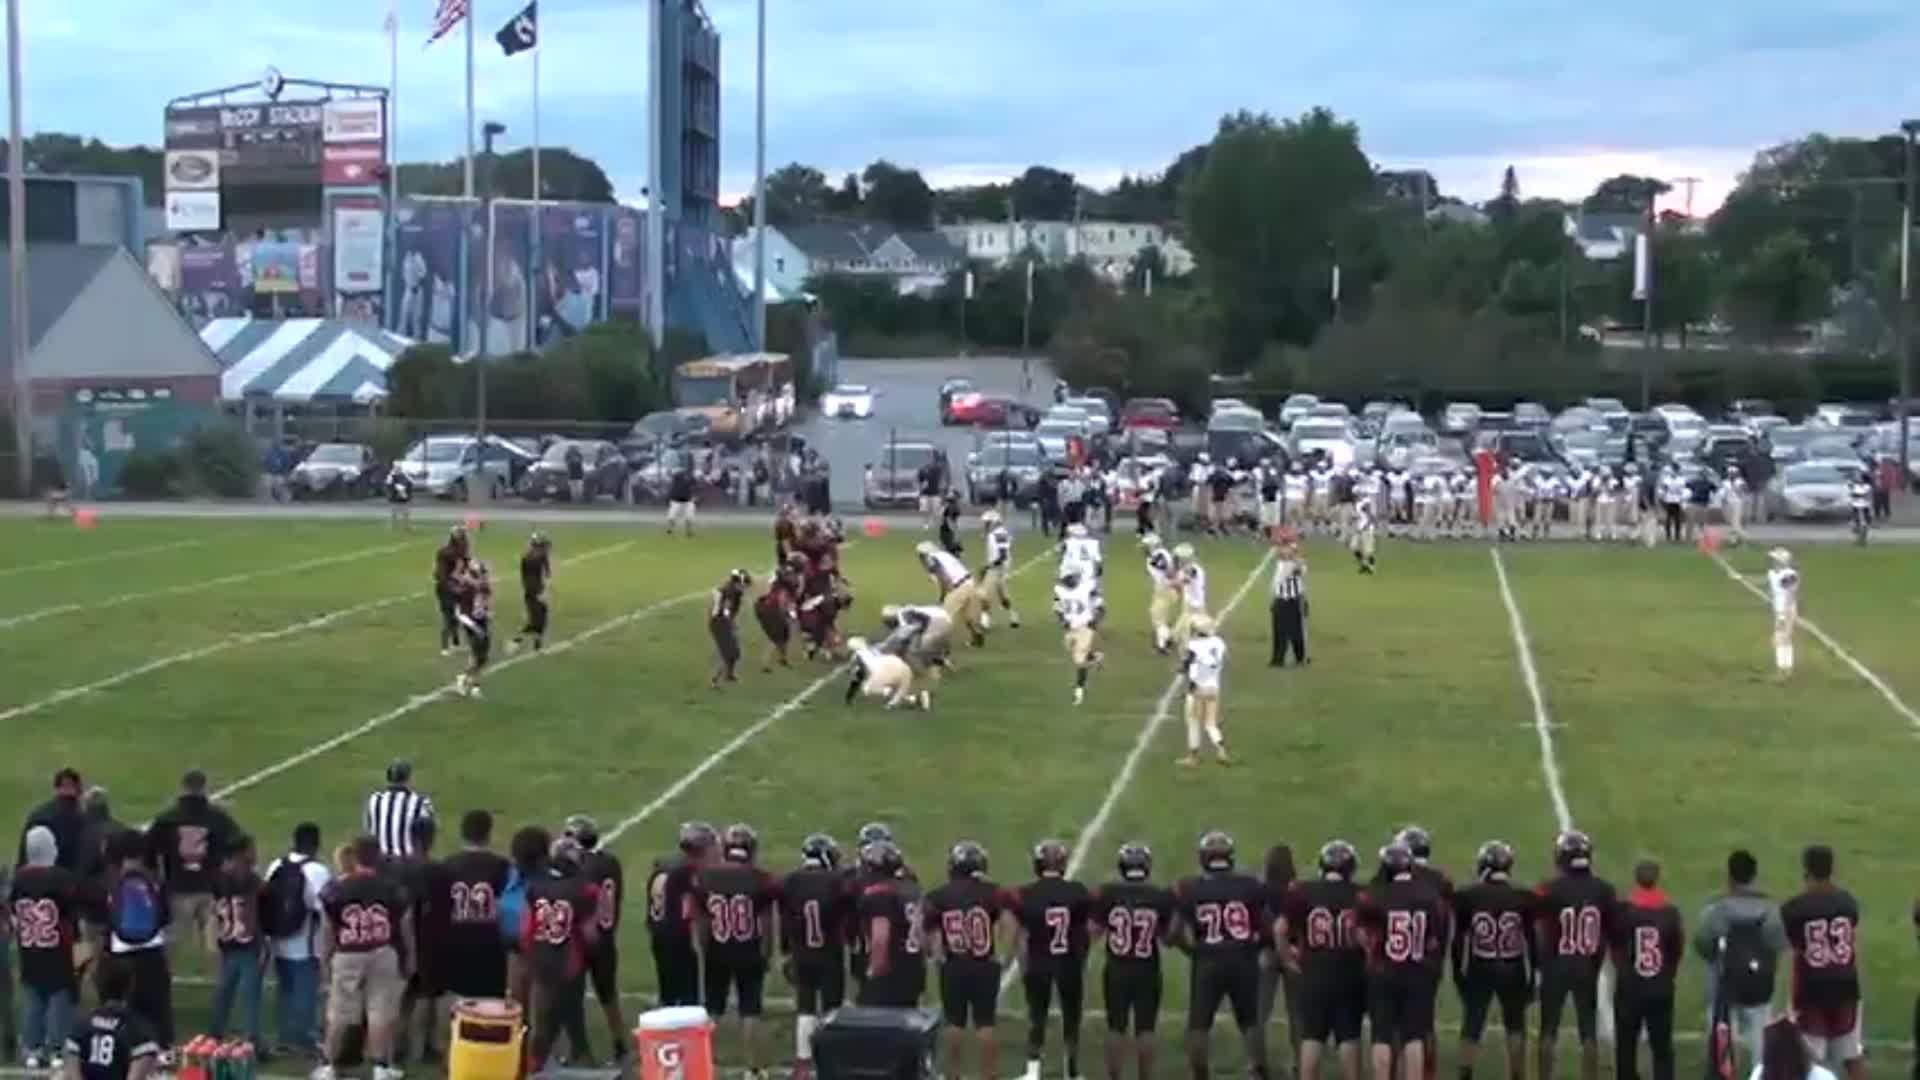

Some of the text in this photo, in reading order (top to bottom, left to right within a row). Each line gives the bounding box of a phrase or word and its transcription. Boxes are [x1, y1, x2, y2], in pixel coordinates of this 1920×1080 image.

[804, 899, 824, 948] 1
[942, 906, 991, 956] 50
[1045, 906, 1071, 954] 7
[1108, 906, 1158, 957] 37
[1385, 911, 1426, 961] 51
[1558, 907, 1601, 956] 10
[1804, 917, 1852, 967] 53
[1634, 927, 1663, 977] 5
[90, 1034, 114, 1065] 18
[657, 1042, 681, 1068] G
